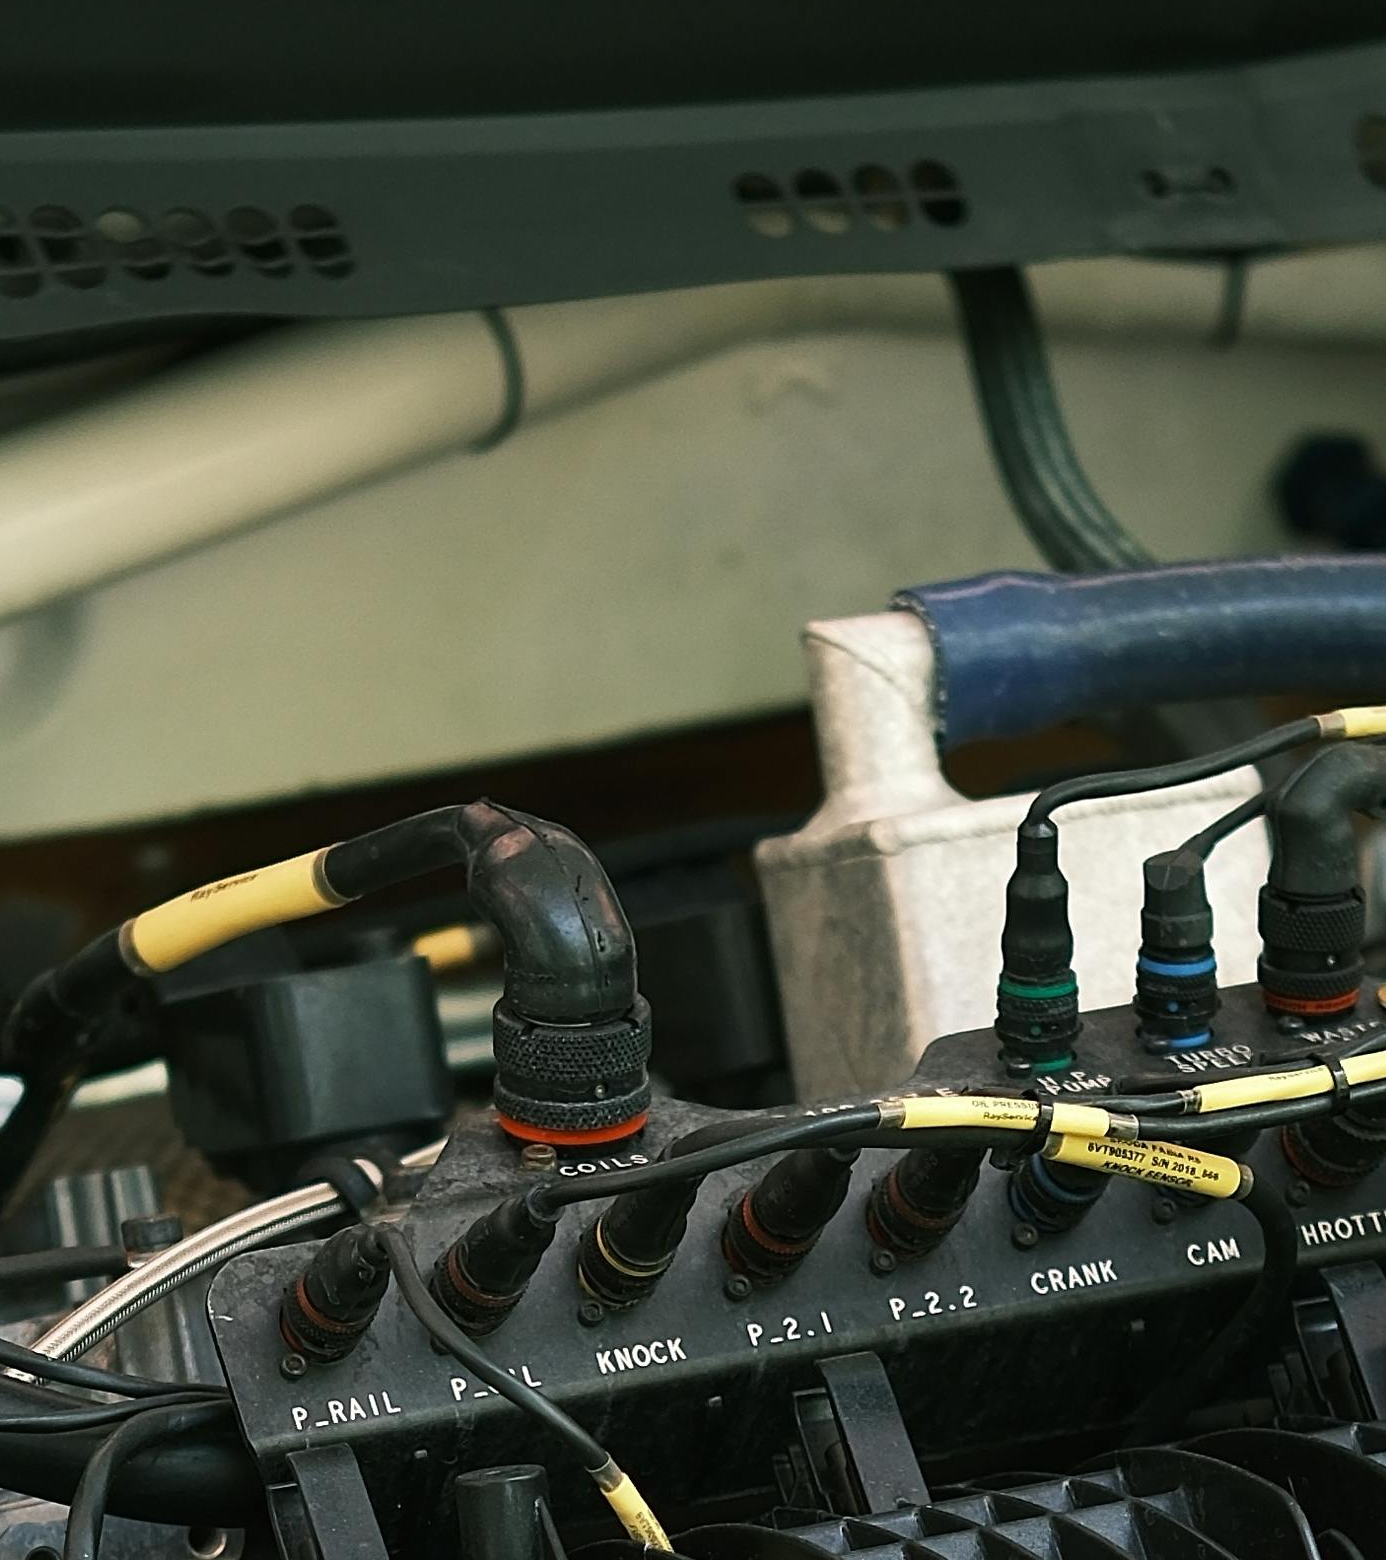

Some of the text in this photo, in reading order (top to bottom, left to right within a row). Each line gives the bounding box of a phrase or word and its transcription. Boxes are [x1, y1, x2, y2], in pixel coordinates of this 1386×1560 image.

[558, 1151, 651, 1180] COILS
[1186, 1237, 1241, 1268] CAM
[1029, 1258, 1119, 1296] CRANK
[888, 1284, 979, 1321] P_2.2
[594, 1336, 688, 1376] KNOCK
[449, 1364, 543, 1402] P_L
[292, 1390, 402, 1432] P_RAIL
